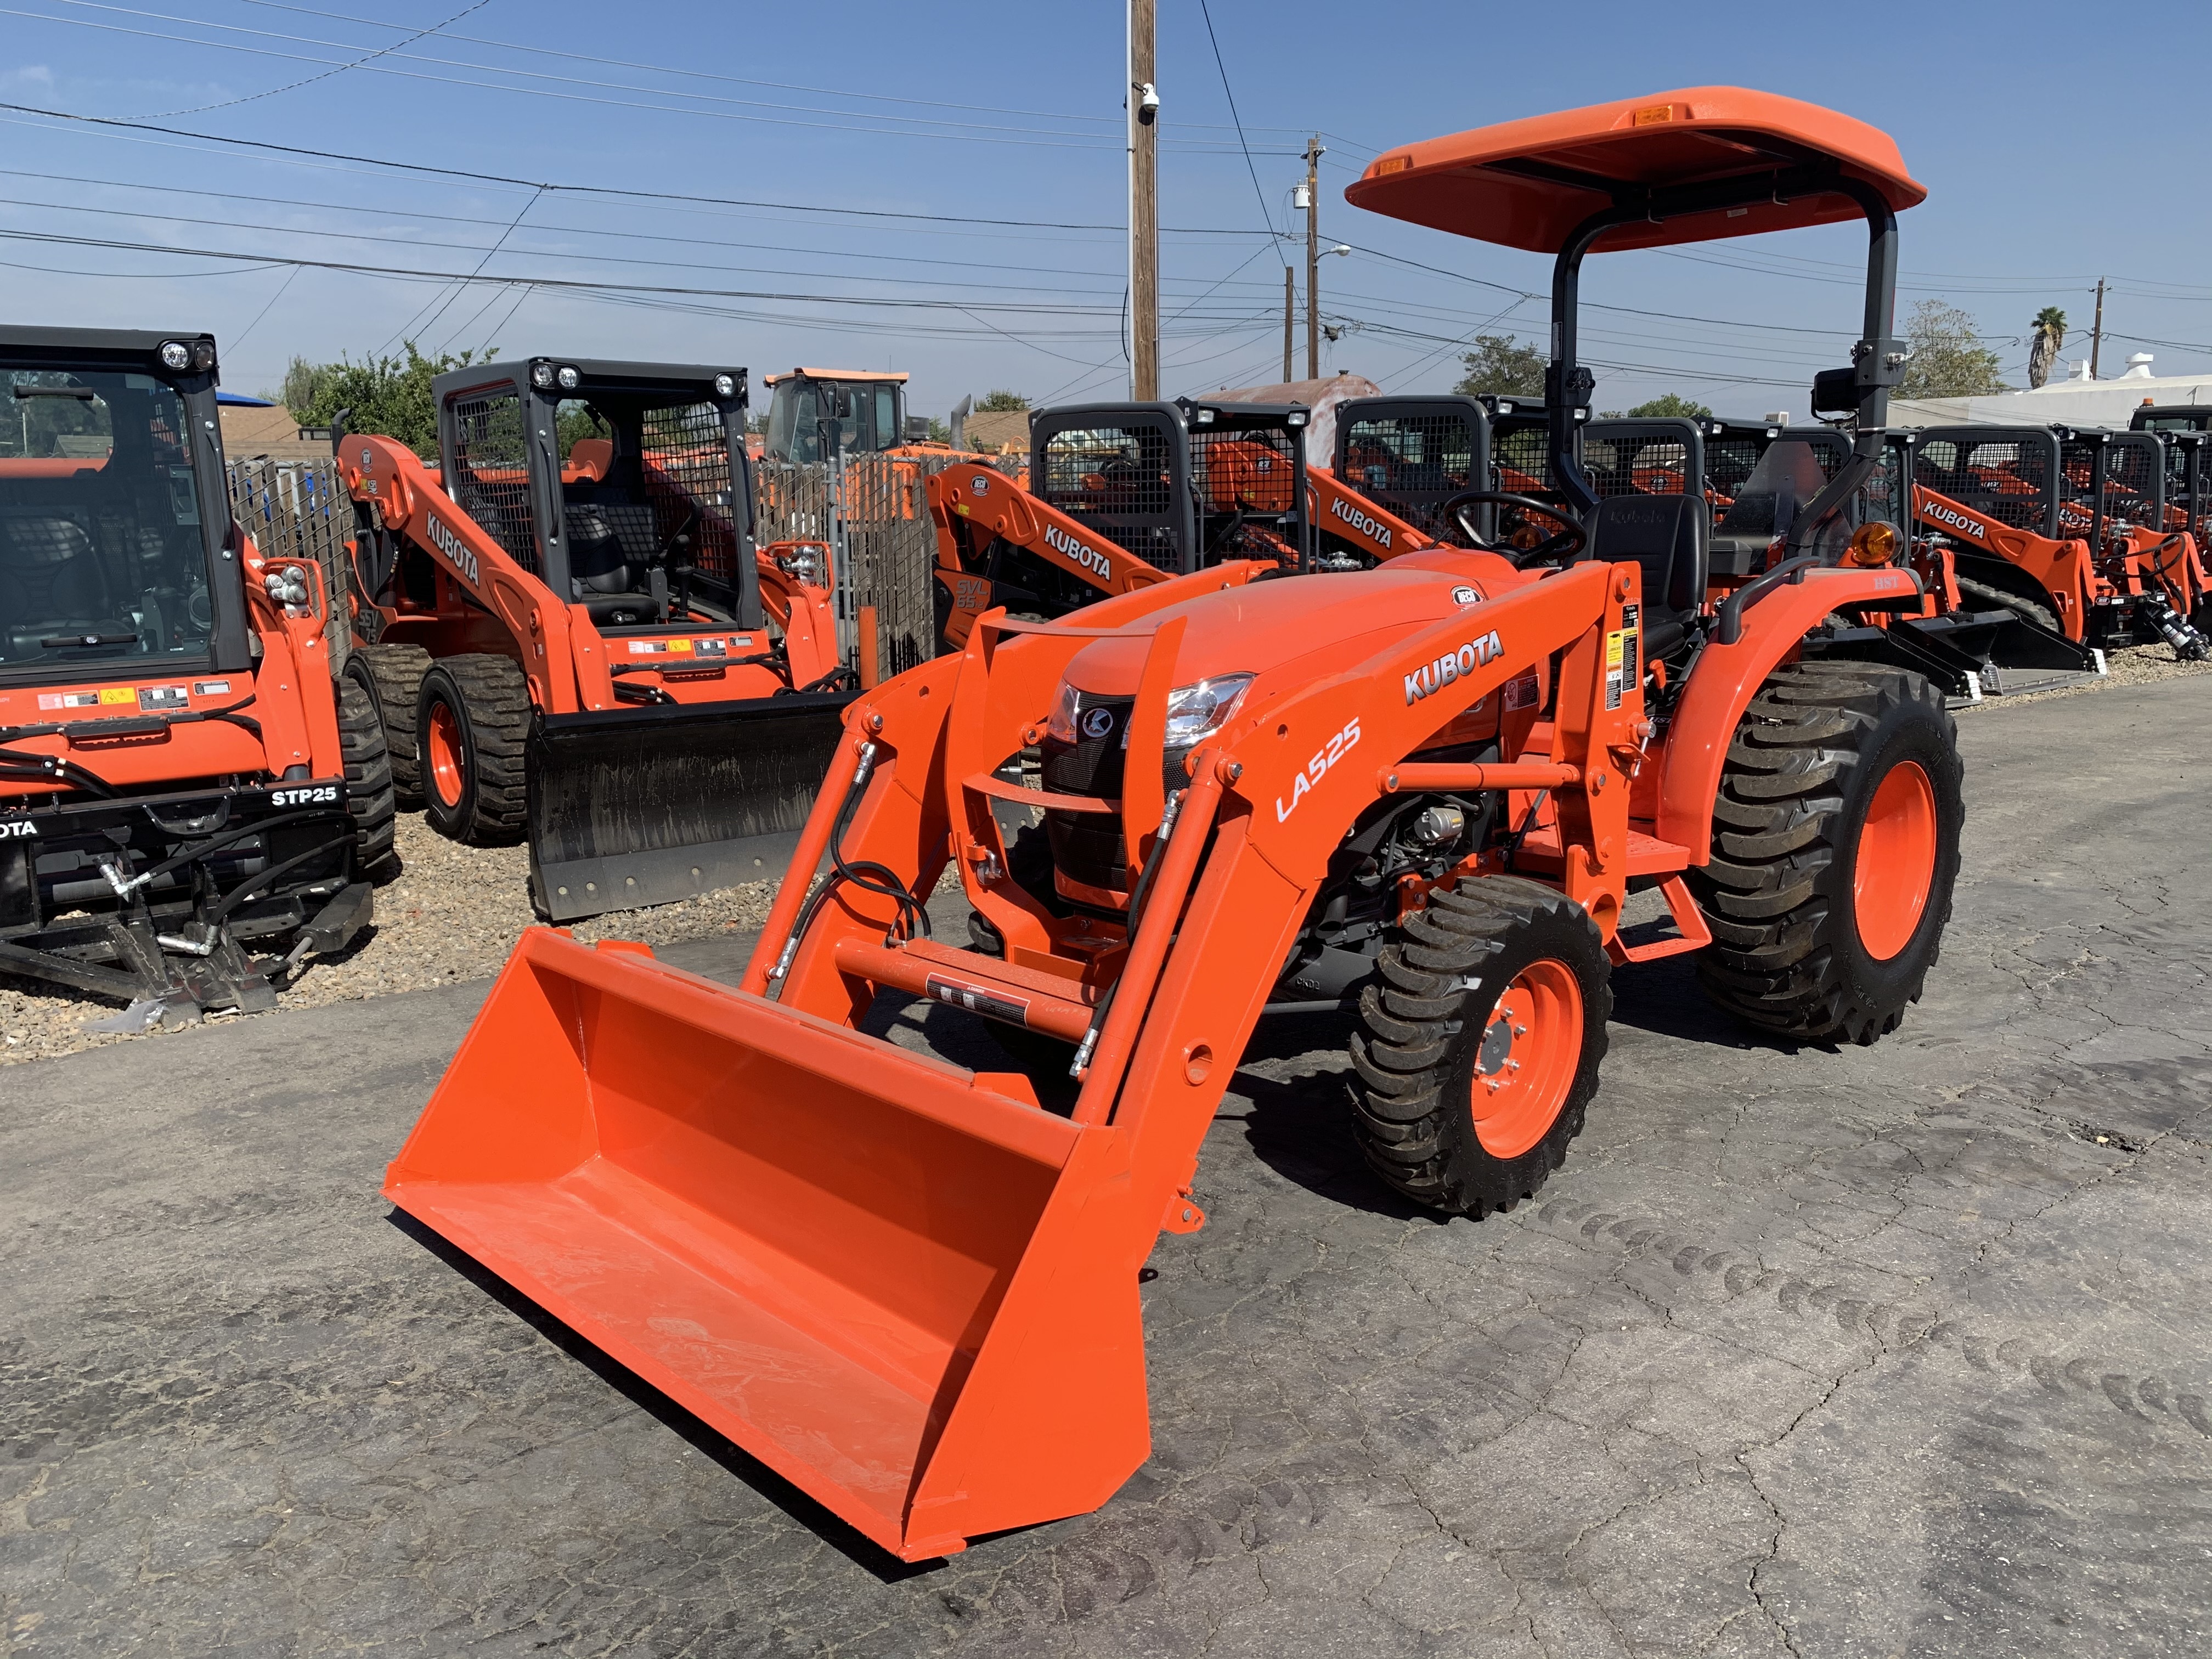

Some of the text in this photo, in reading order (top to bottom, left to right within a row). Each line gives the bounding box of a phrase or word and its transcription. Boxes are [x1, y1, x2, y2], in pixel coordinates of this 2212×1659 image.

[974, 479, 986, 488] BECO
[1331, 496, 1392, 549] KUBOTA
[1923, 500, 1984, 539] KUBOTA
[427, 510, 479, 587] KUBOTA
[1044, 523, 1110, 582] KUBOTA
[956, 580, 988, 595] SVL
[1874, 576, 1899, 590] HST
[1457, 590, 1476, 602] BECO
[358, 609, 379, 628] SSV
[366, 628, 376, 643] 75
[1404, 629, 1504, 706] KUBOTA
[1276, 716, 1361, 823] LA525
[272, 787, 336, 805] STP25
